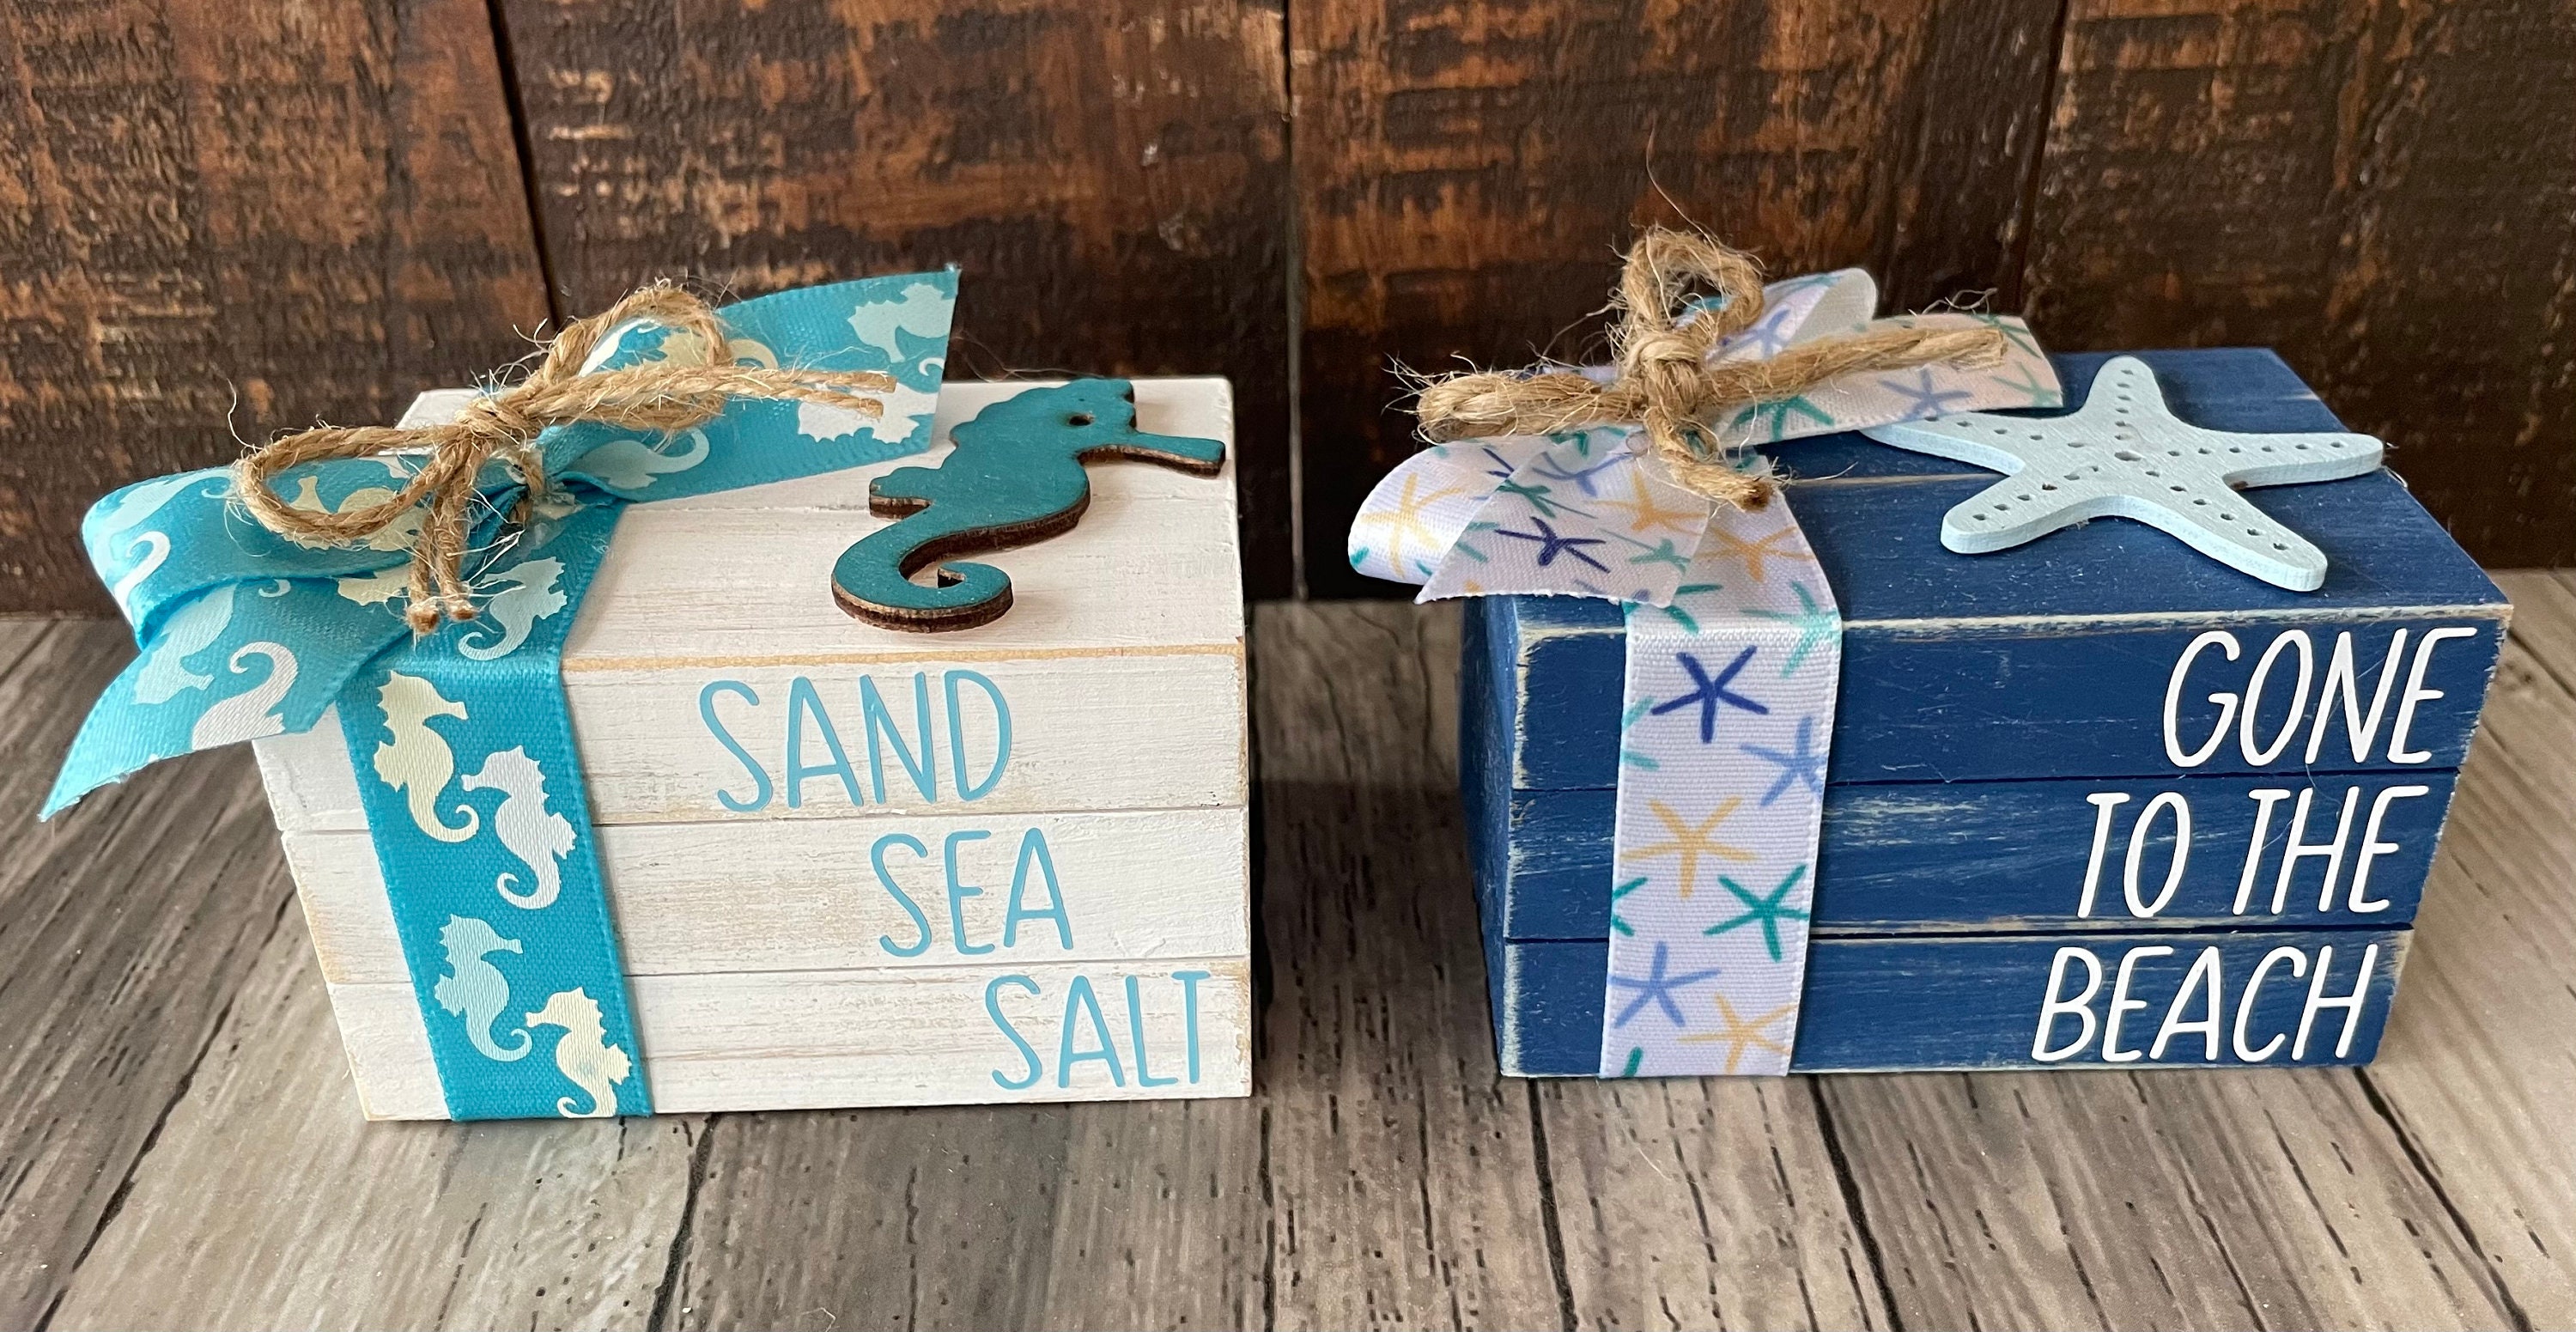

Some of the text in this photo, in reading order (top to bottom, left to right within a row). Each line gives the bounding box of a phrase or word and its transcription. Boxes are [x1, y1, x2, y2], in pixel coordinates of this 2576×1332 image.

[699, 669, 1012, 812] SAND
[2162, 627, 2478, 769] GONE
[870, 827, 1074, 958] SEA
[2076, 785, 2430, 919] TO THE
[984, 970, 1212, 1091] SALT
[2031, 943, 2379, 1062] BEACH
